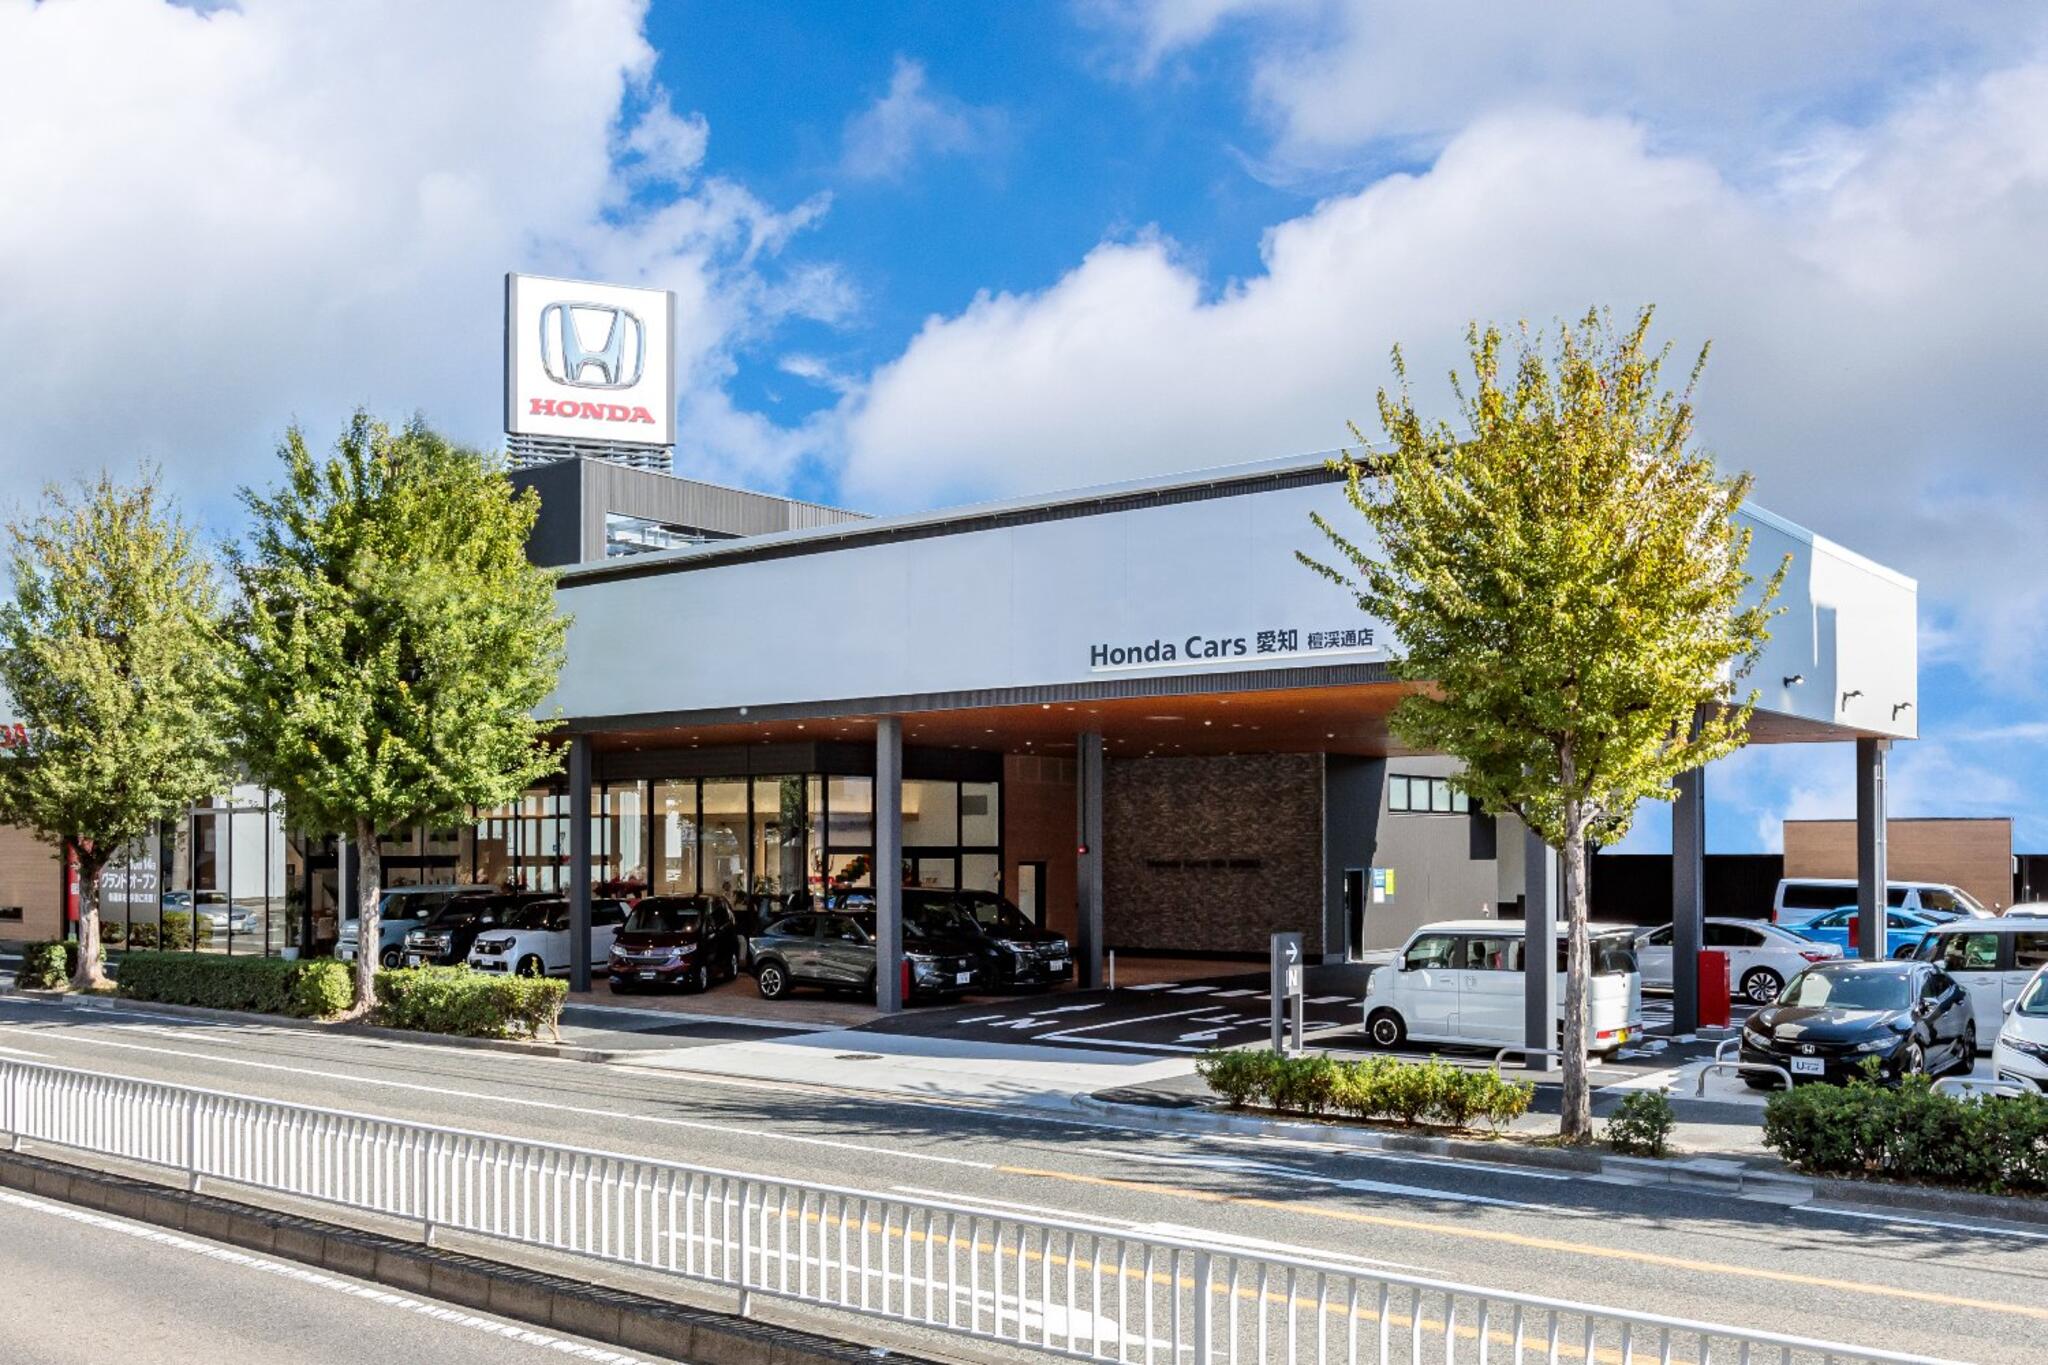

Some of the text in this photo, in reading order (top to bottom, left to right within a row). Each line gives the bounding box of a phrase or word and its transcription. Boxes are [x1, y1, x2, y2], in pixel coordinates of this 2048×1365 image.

[529, 398, 656, 424] HONDA
[1090, 640, 1176, 666] Honda
[1185, 636, 1247, 658] Cars
[1257, 629, 1298, 653] 愛知
[1286, 969, 1298, 987] IN
